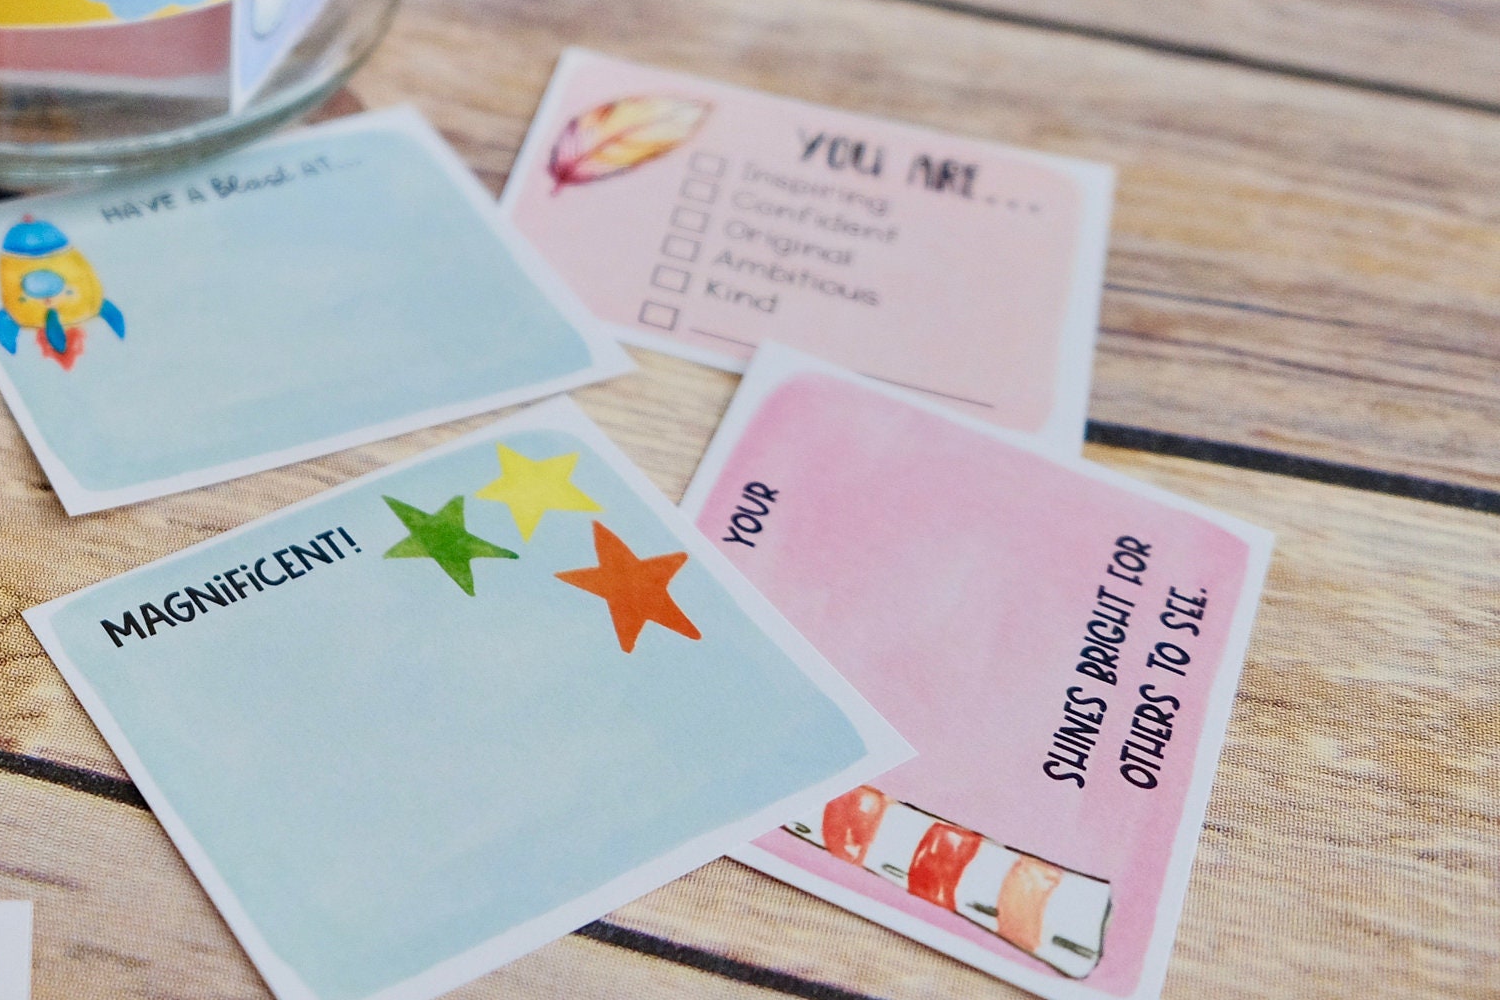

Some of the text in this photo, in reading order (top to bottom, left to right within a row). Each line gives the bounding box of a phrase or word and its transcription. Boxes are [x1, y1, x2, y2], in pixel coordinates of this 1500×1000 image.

[799, 129, 887, 178] YOU
[101, 192, 176, 224] HAVE
[187, 183, 207, 204] A
[729, 188, 899, 245] Confident
[739, 160, 891, 217] Inspiring
[721, 216, 854, 267] Original
[703, 278, 780, 315] Kind
[711, 249, 881, 308] Ambitious
[722, 480, 780, 549] YOUR
[1042, 534, 1153, 789] SHINES BRIGHT FOR
[1119, 586, 1210, 791] OTHERS TO SEE.
